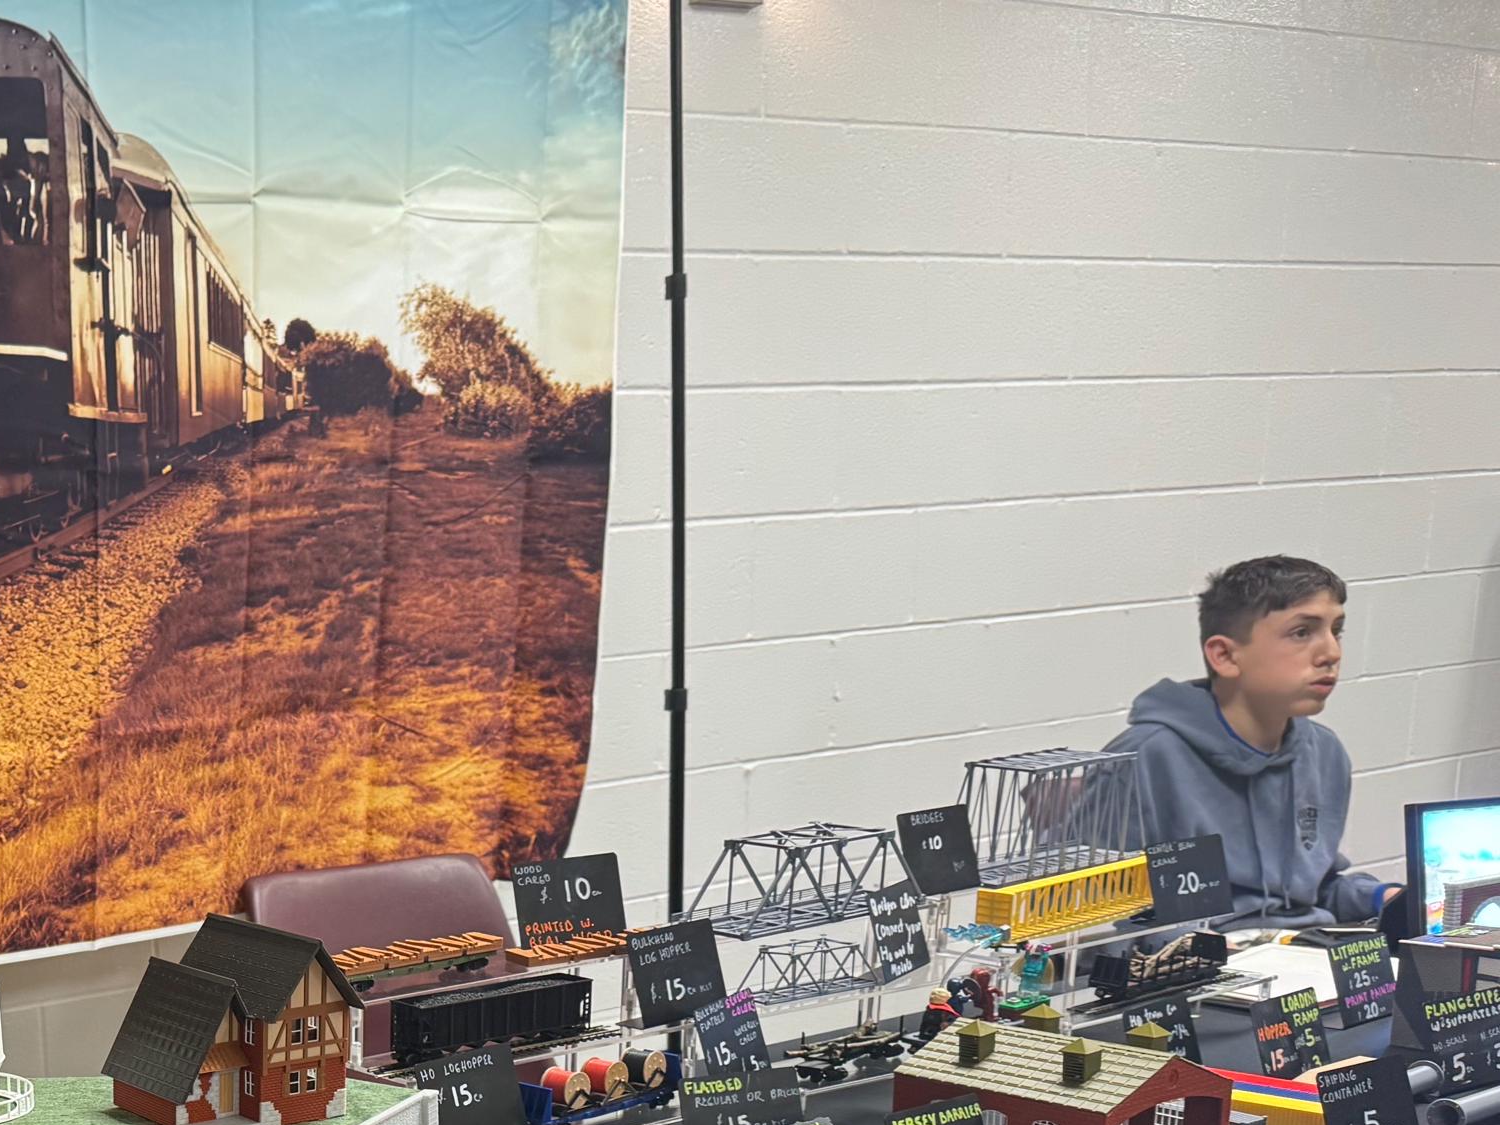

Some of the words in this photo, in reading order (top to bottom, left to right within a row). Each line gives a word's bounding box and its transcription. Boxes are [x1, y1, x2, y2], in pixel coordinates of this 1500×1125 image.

[910, 811, 945, 827] BRIDGES
[514, 864, 543, 876] WOOD
[517, 873, 551, 887] CARGO
[564, 877, 591, 903] 10
[1177, 871, 1200, 895] 20
[525, 919, 574, 936] PRINTED
[631, 931, 675, 951] BULKHEAD
[1331, 935, 1389, 961] LITHOPHANE
[640, 951, 658, 967] LOG
[660, 941, 692, 961] HOPPER
[1351, 950, 1381, 970] FRAME
[1354, 969, 1371, 989] 25
[731, 1000, 757, 1017] COLORS
[1293, 1007, 1319, 1028] RAMP
[1363, 1001, 1379, 1020] 20
[420, 1067, 436, 1083] HO
[1452, 1052, 1467, 1082] 5
[451, 1083, 473, 1108] 15
[684, 1076, 743, 1096] FLATBED
[1322, 1077, 1374, 1103] CONTAINER
[695, 1093, 740, 1109] REGULAR
[746, 1091, 765, 1103] OR
[938, 1102, 983, 1125] BARRIER
